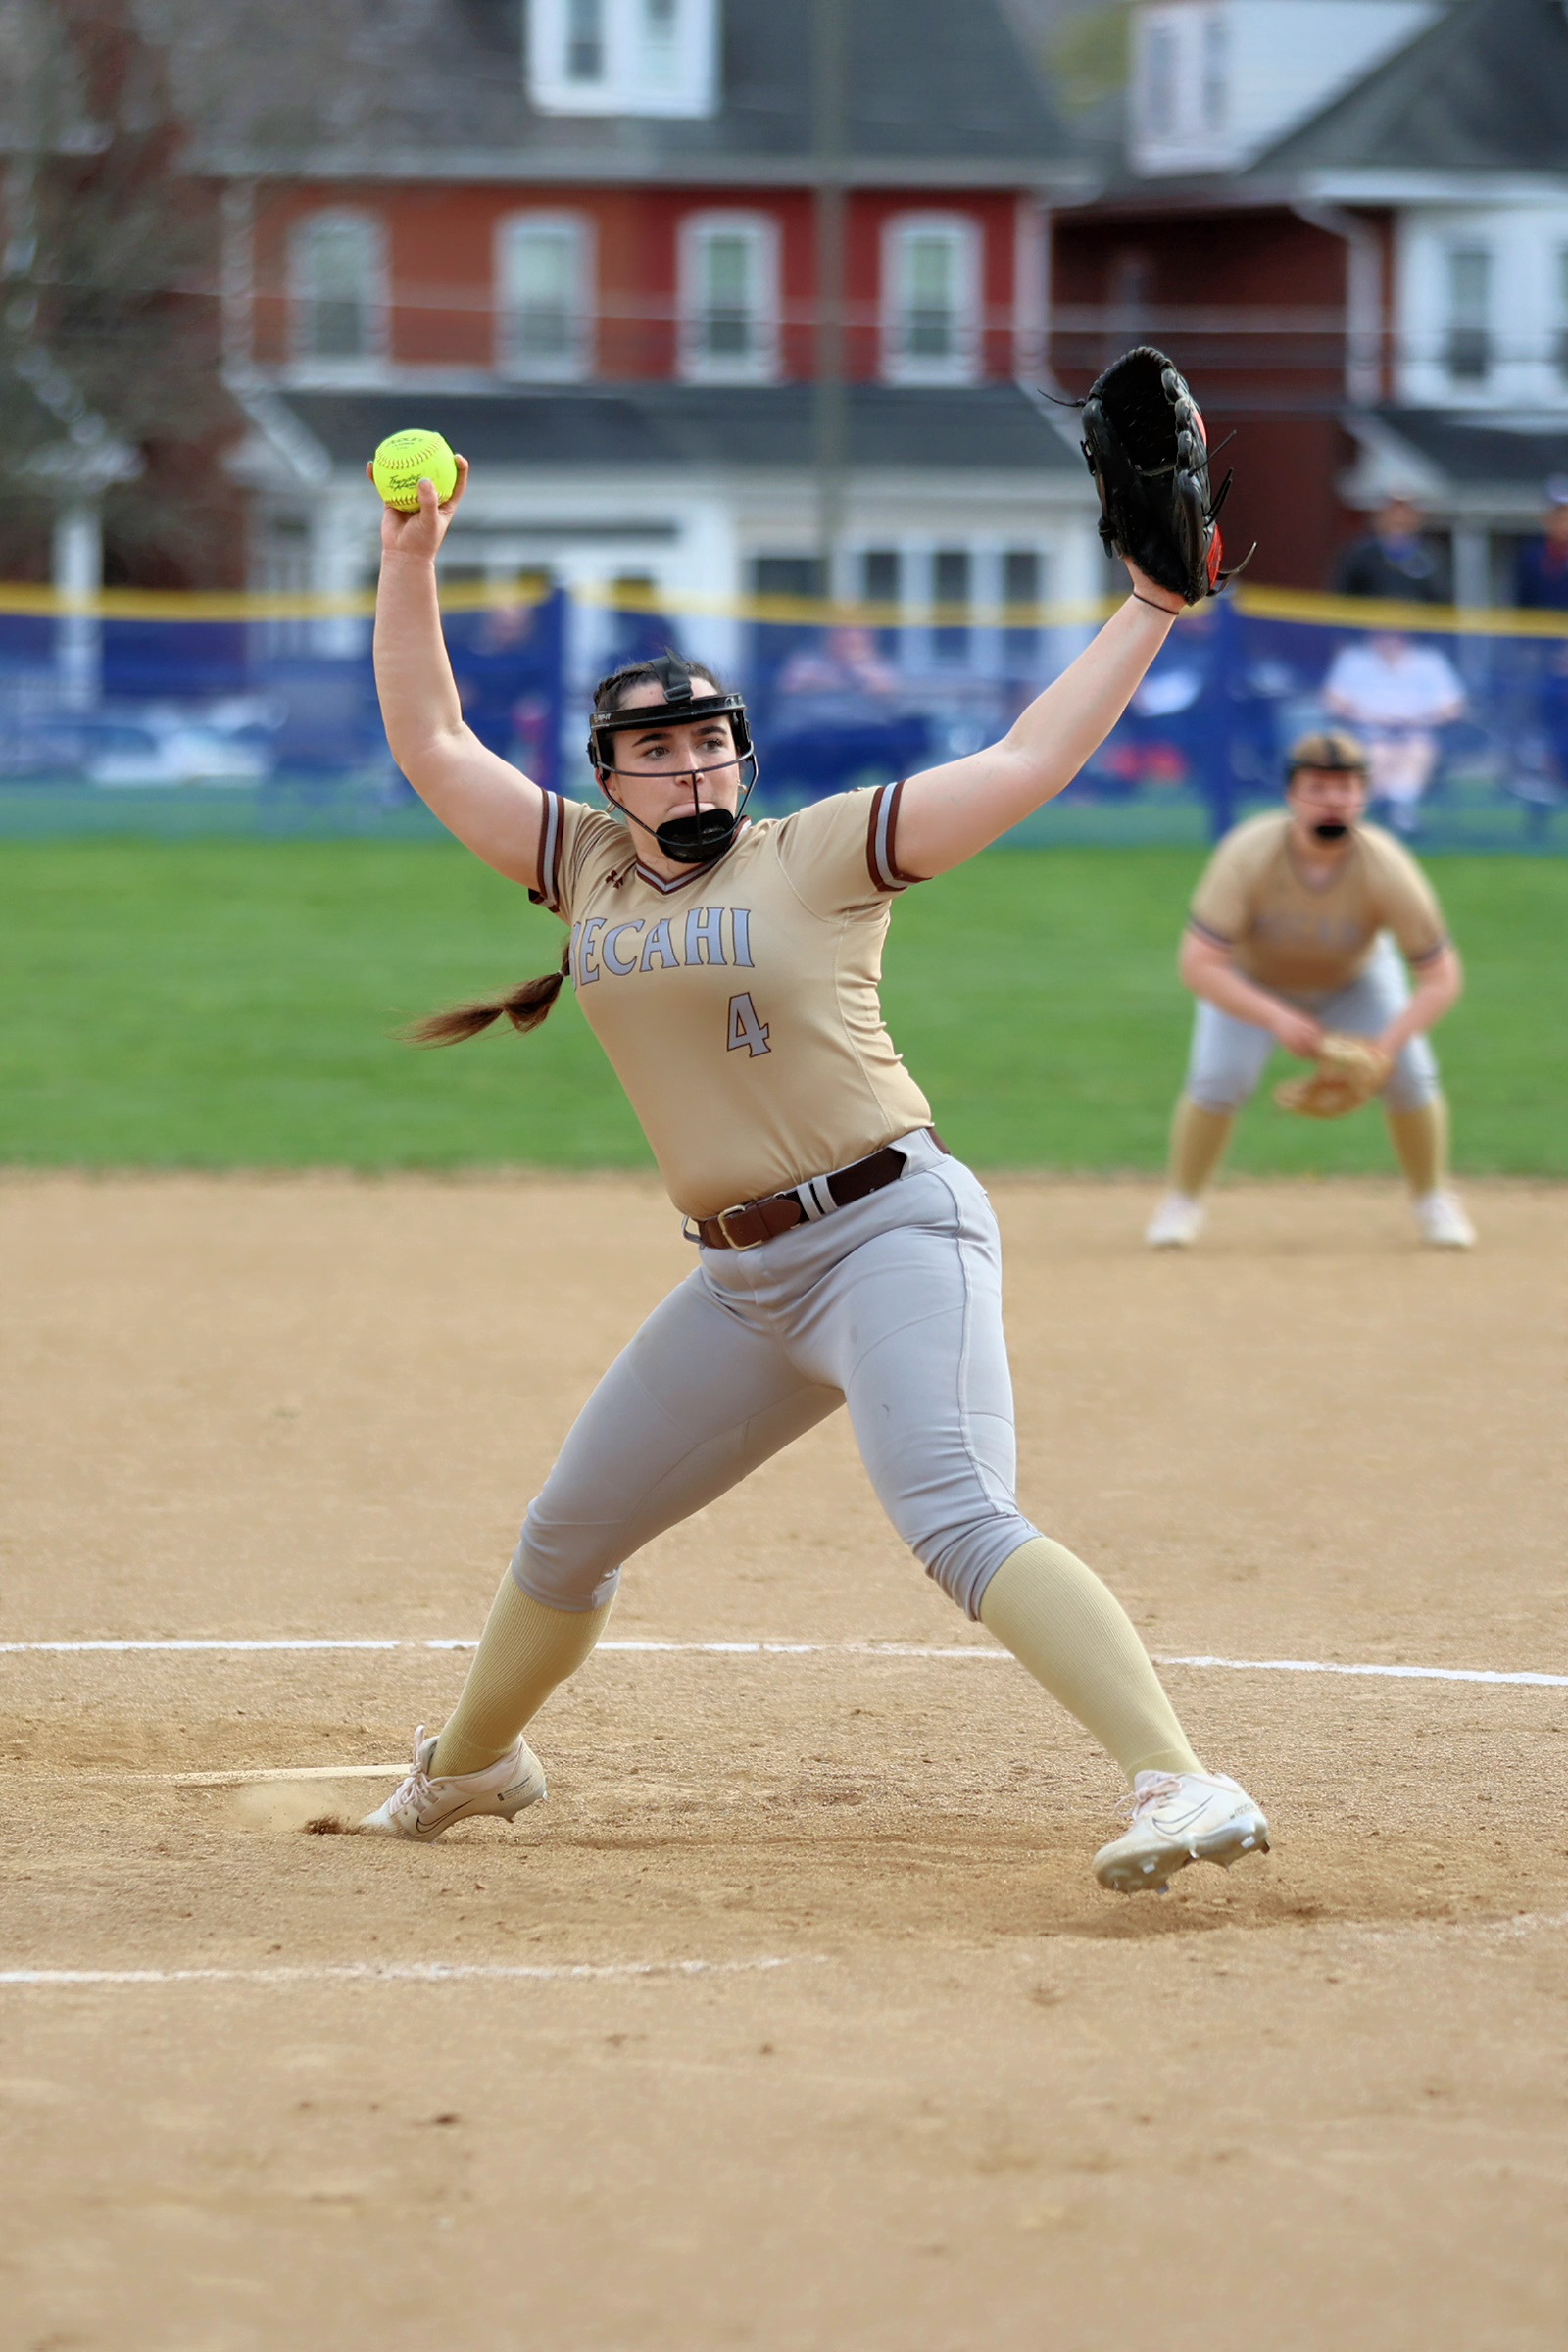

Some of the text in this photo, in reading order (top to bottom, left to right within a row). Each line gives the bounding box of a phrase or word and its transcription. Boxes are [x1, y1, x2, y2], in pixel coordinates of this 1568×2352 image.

[389, 473, 423, 485] Thunder
[569, 906, 755, 992] ECAHI
[727, 992, 771, 1058] 4
